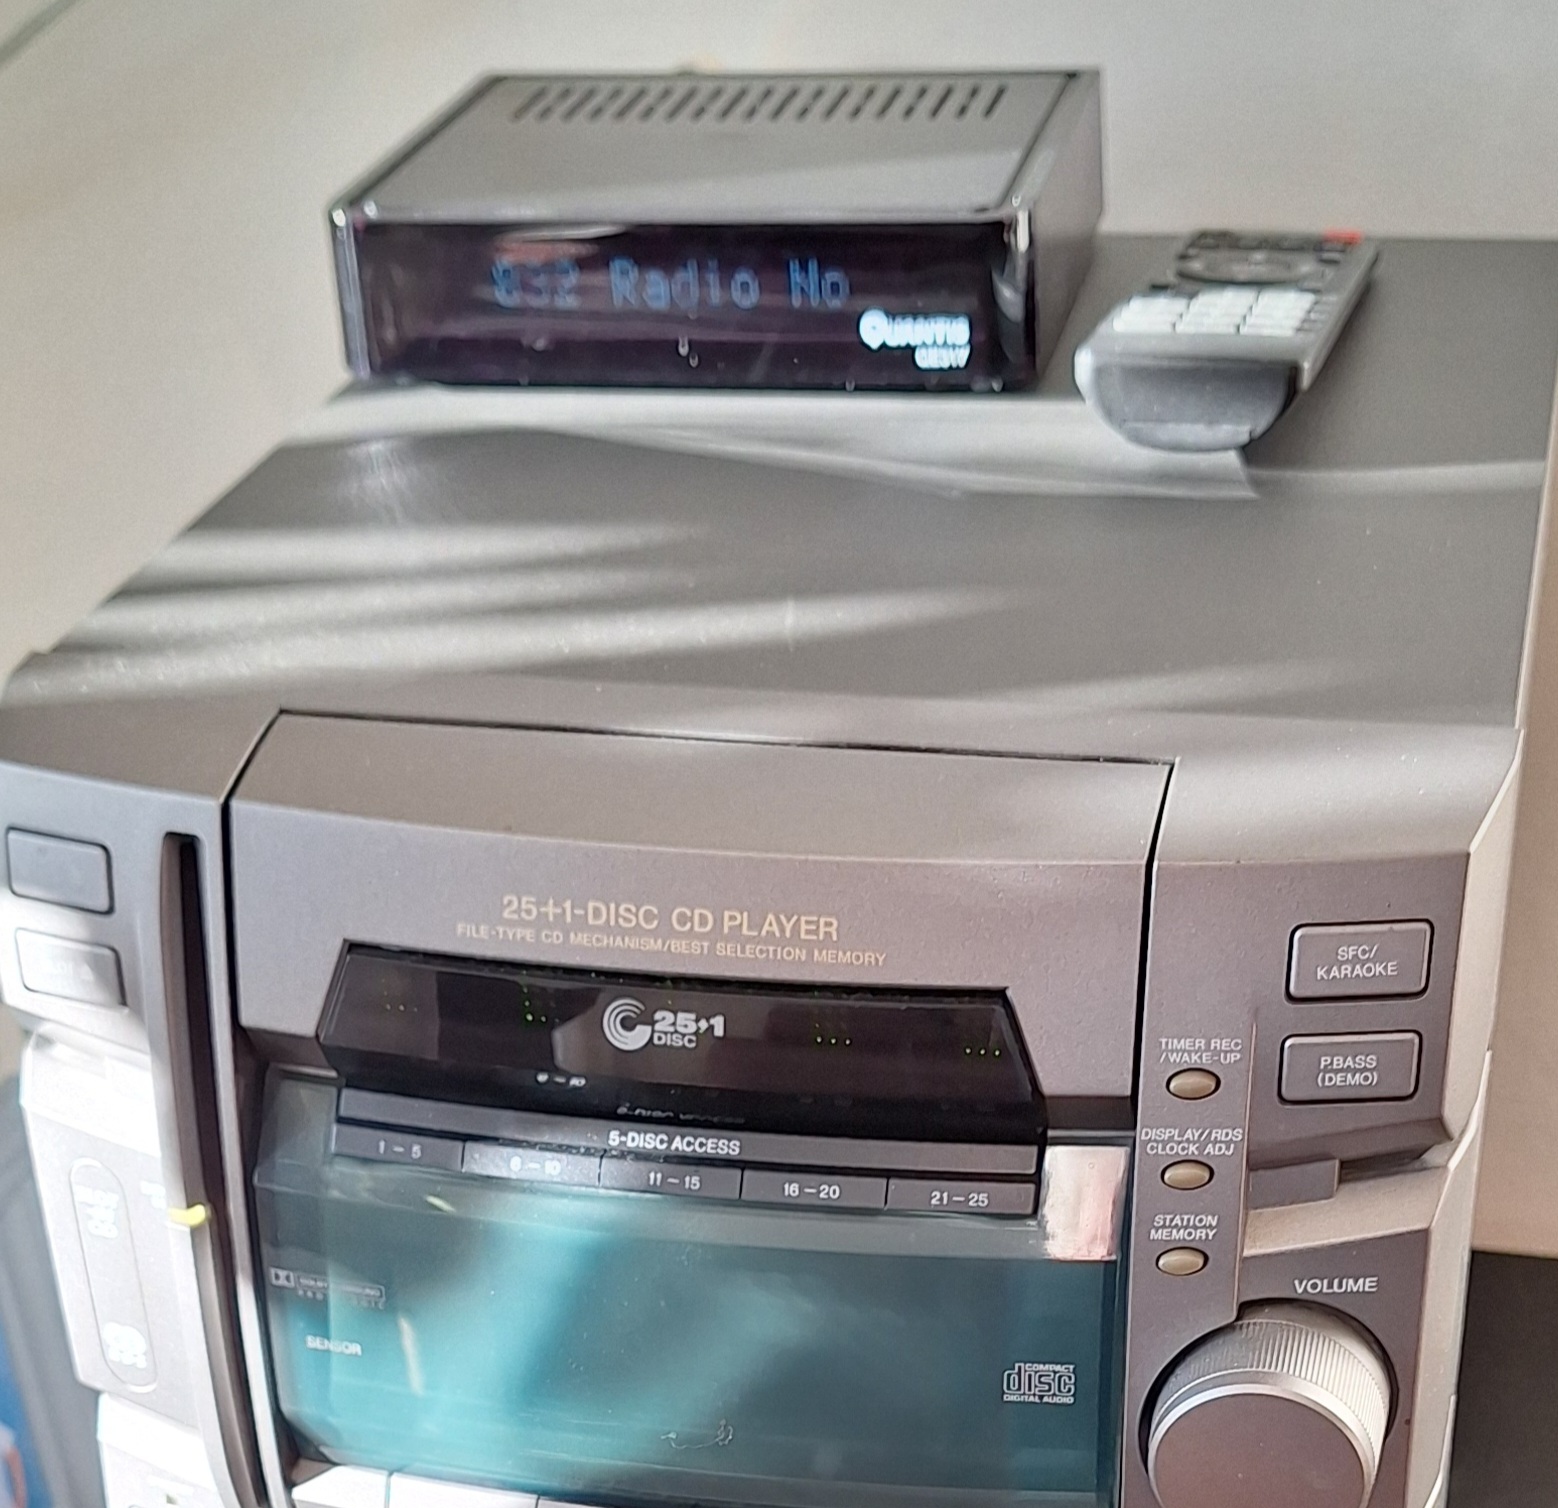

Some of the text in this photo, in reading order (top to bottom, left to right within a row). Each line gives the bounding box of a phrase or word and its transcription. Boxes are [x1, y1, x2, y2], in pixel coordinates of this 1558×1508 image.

[608, 256, 760, 309] Radio
[787, 256, 850, 309] No
[502, 895, 839, 941] 25+1-DISC CD PLAYER
[457, 922, 886, 968] FILE-TYPE CD MECHANISM/BEST SELECTION MEMORY
[1337, 944, 1379, 961] SFC/
[1316, 961, 1398, 980] KARAOKE
[653, 1031, 697, 1049] DISC
[1159, 1038, 1242, 1051] TIMER REC
[1159, 1051, 1241, 1065] /WAKE-UP
[1317, 1070, 1378, 1087] (DEMO)
[608, 1130, 741, 1156] 5-DISC ACCESS
[1140, 1128, 1243, 1142] DISPLAY/RDS
[1146, 1142, 1235, 1156] CLOCK ADJ
[1153, 1214, 1219, 1227] STATION
[1149, 1227, 1218, 1242] MEMORY
[1293, 1276, 1379, 1294] VOLUME
[305, 1334, 363, 1356] SENSOR
[1025, 1363, 1075, 1373] COMPACT
[1003, 1363, 1076, 1396] disc
[1003, 1394, 1075, 1404] DIGITAL AUDIO
